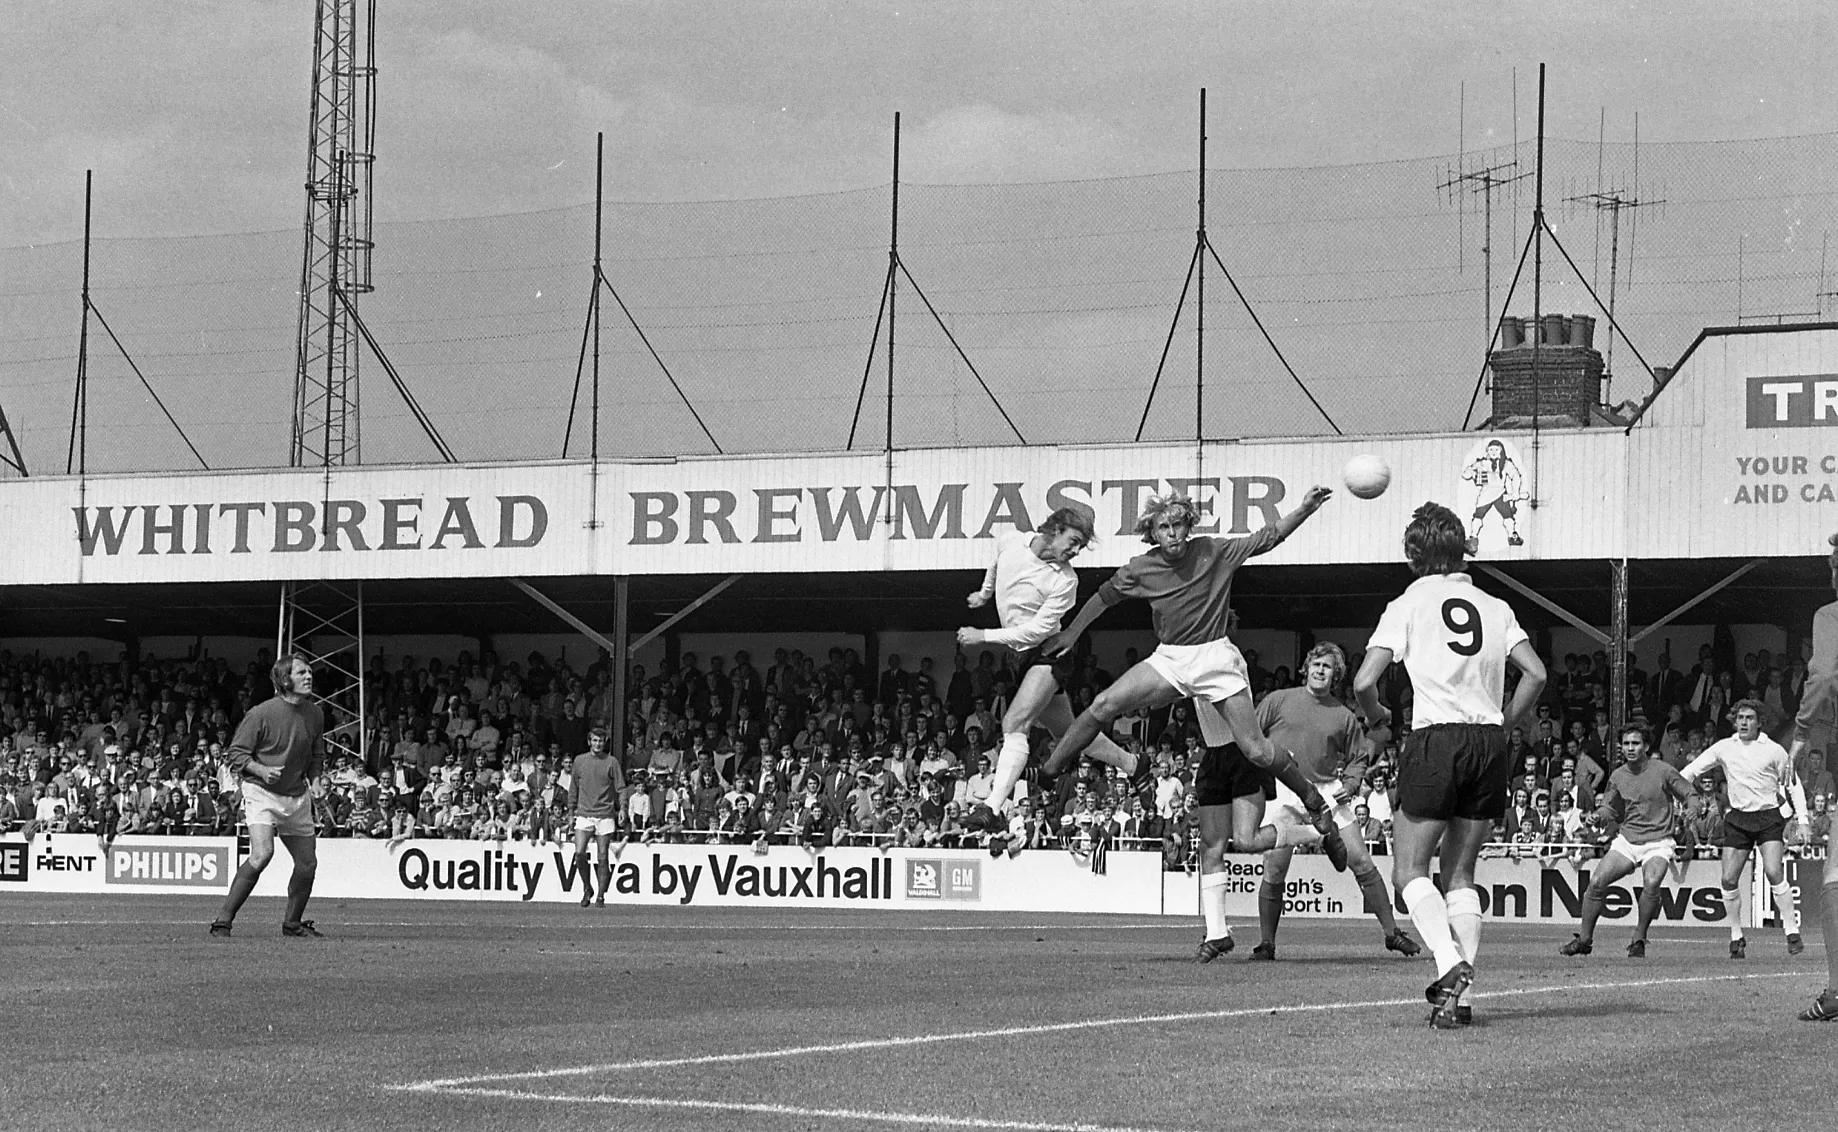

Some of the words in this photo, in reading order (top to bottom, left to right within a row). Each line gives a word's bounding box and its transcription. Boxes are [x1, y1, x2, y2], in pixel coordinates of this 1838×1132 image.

[1735, 456, 1808, 476] YOUR
[1733, 483, 1789, 504] AND
[72, 494, 549, 557] WHITBREAD
[627, 475, 1287, 546] BREWMASTER
[1441, 597, 1483, 657] 9
[36, 855, 97, 872] RENT
[114, 850, 218, 881] PHILIPS
[399, 847, 544, 900] Quality
[652, 856, 702, 904] by
[708, 854, 893, 900] Vauxhall
[952, 867, 973, 886] GM
[1326, 896, 1343, 913] in
